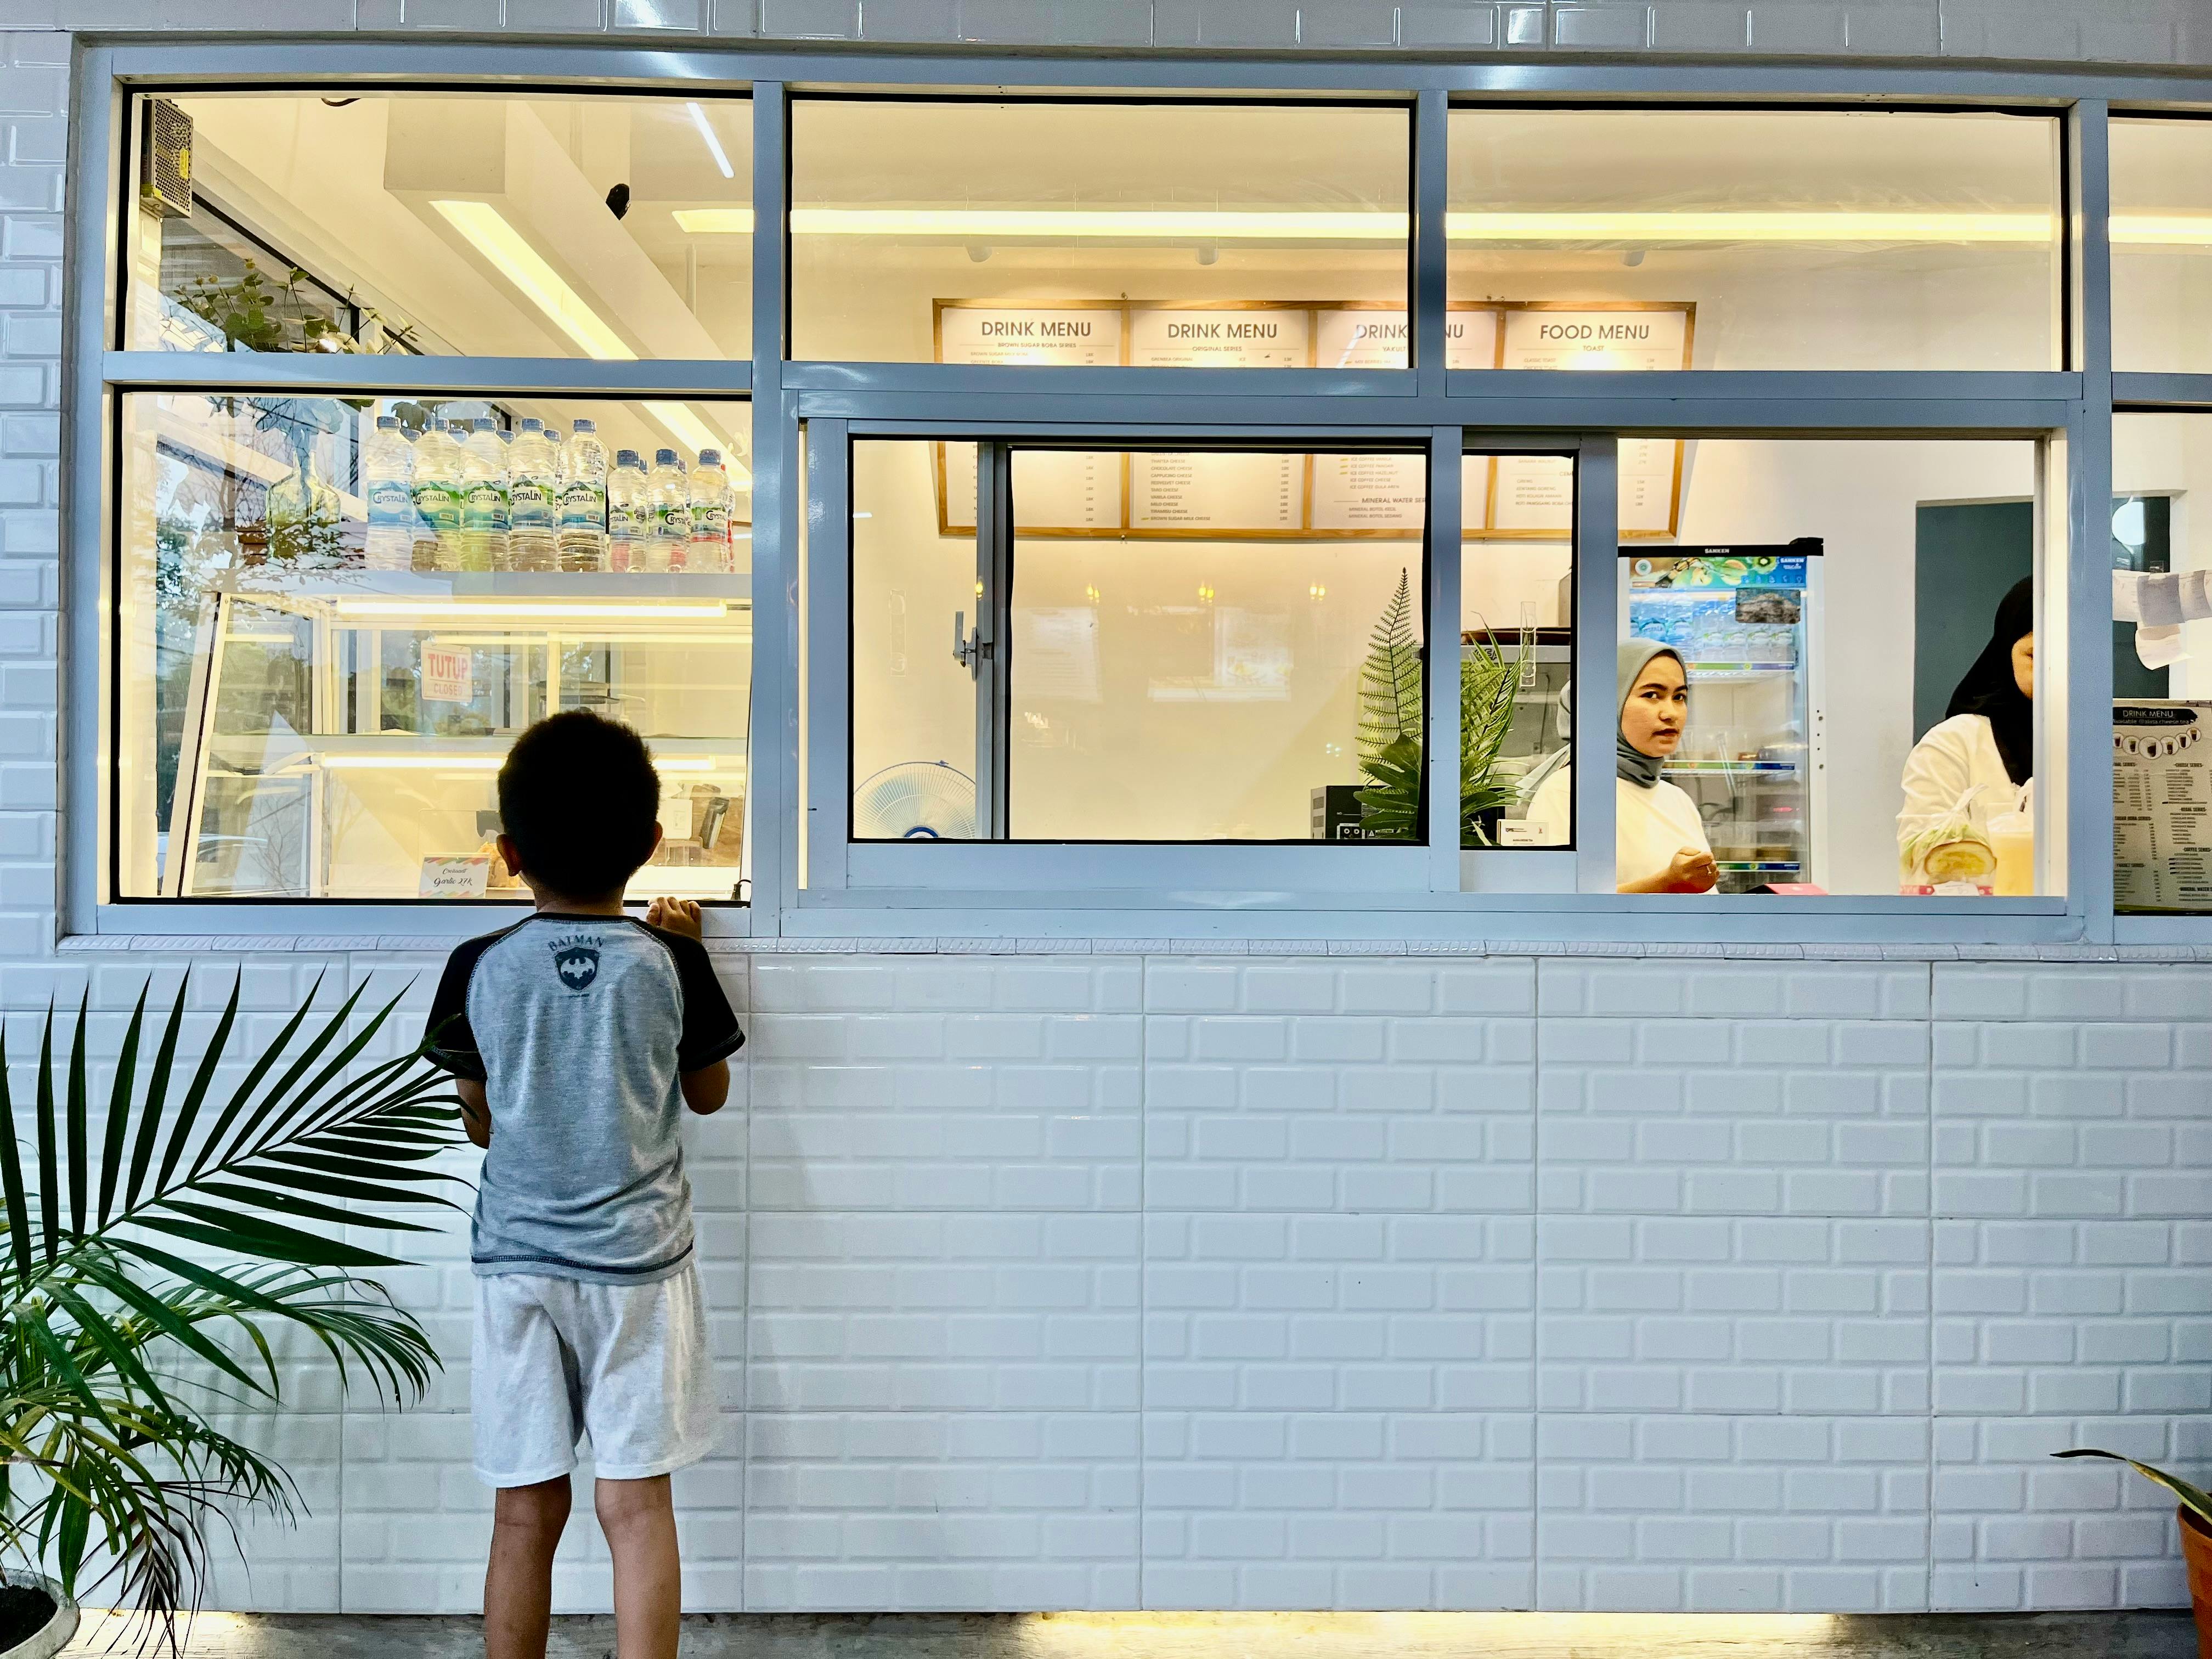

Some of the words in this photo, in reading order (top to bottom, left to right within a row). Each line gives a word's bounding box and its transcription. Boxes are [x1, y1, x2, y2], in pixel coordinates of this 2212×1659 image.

[982, 321, 1035, 336] DRINK
[1041, 322, 1091, 336] MENU
[1168, 324, 1221, 338] DRINK
[1227, 324, 1277, 338] MENU
[1356, 325, 1408, 338] DRINK
[1541, 325, 1592, 339] FOOD
[1599, 325, 1649, 339] MENU
[428, 653, 468, 680] TUTUP
[434, 684, 462, 696] CLOSED
[433, 877, 456, 888] Garlic
[548, 935, 605, 951] BATMAN
